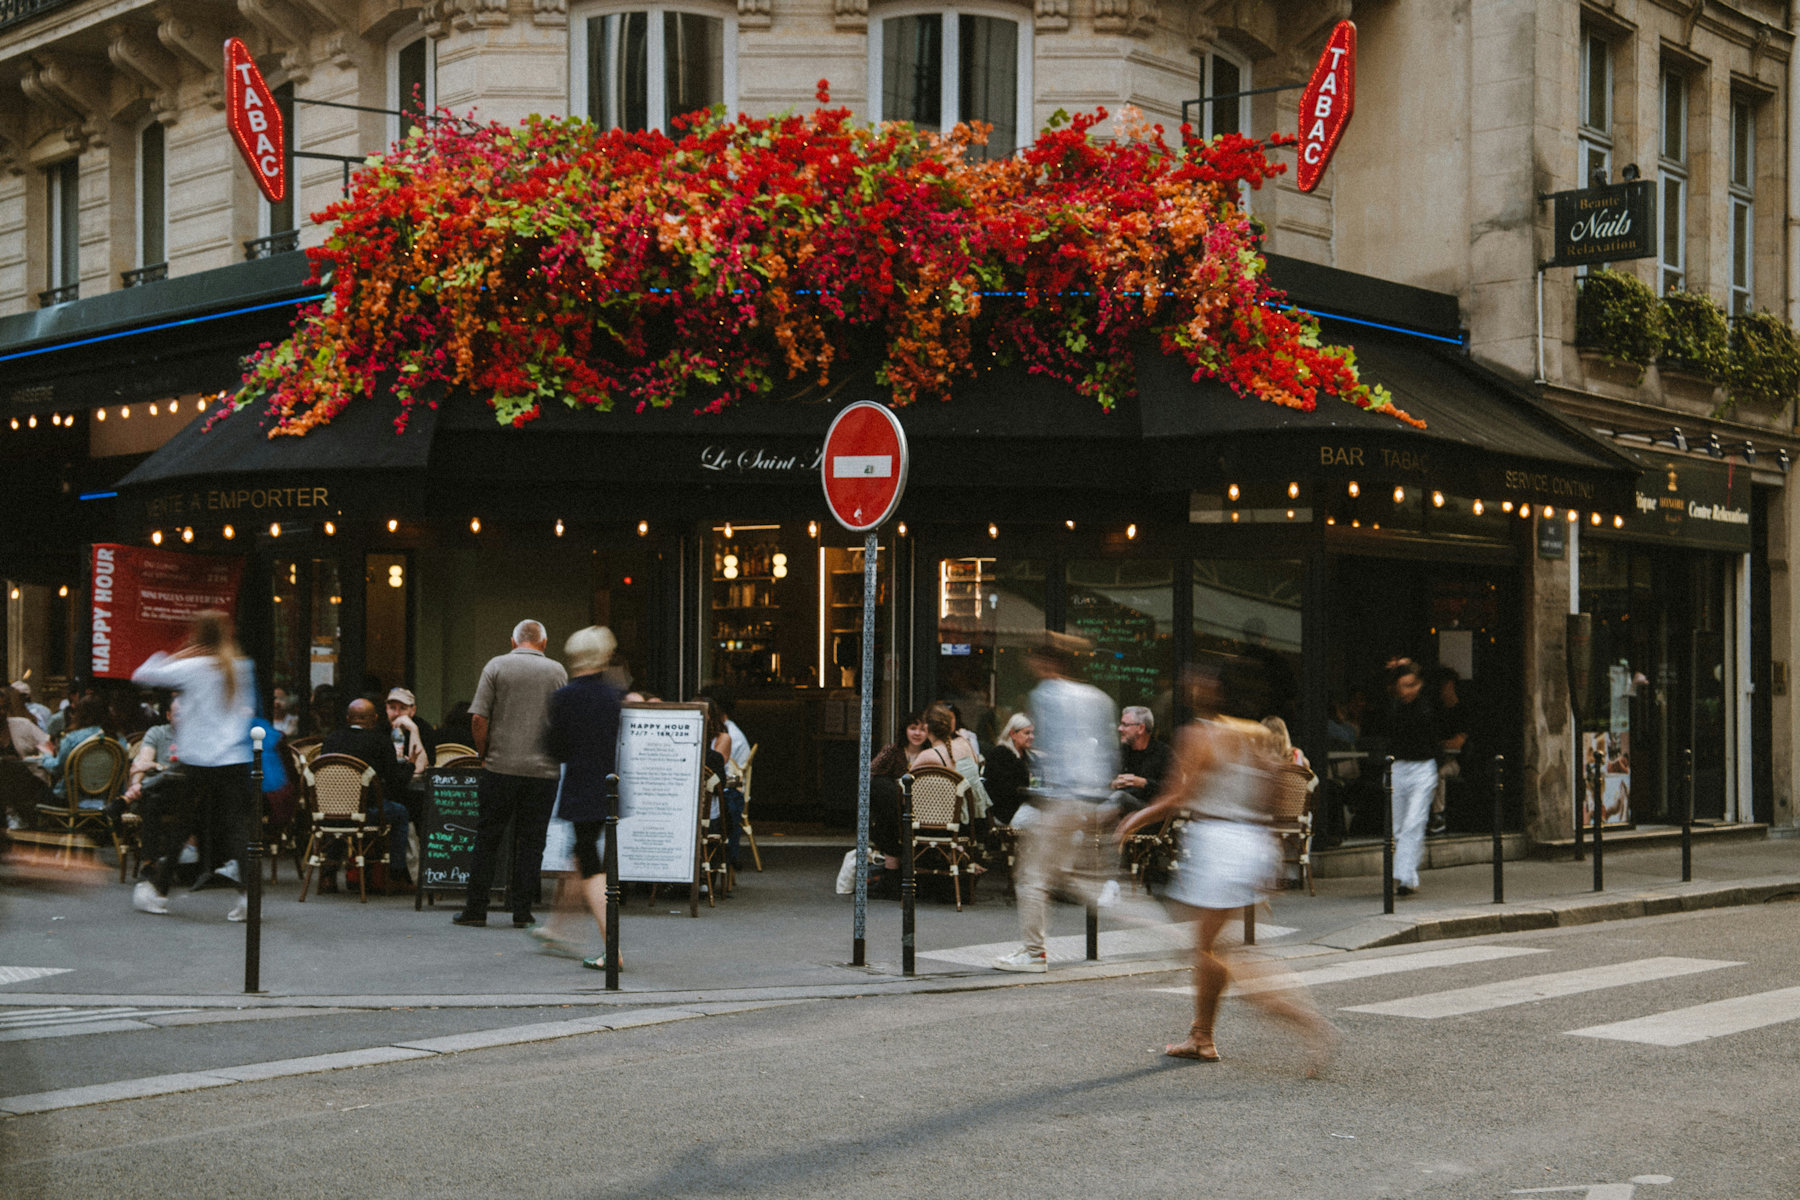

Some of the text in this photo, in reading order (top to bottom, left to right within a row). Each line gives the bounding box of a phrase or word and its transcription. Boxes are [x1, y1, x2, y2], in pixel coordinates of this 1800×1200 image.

[1303, 46, 1346, 165] TABAC
[235, 62, 280, 178] TABAC
[1569, 207, 1632, 242] Nails
[1566, 239, 1637, 256] Relaxation
[700, 445, 732, 471] Le
[737, 448, 797, 472] Saint
[1320, 446, 1430, 472] BAR TABAC
[1505, 470, 1548, 492] SERVICE
[207, 487, 329, 510] EMPORTER
[1688, 500, 1712, 520] Centre
[1712, 504, 1750, 525] Relaxation
[91, 547, 116, 673] HAPPY HOUR
